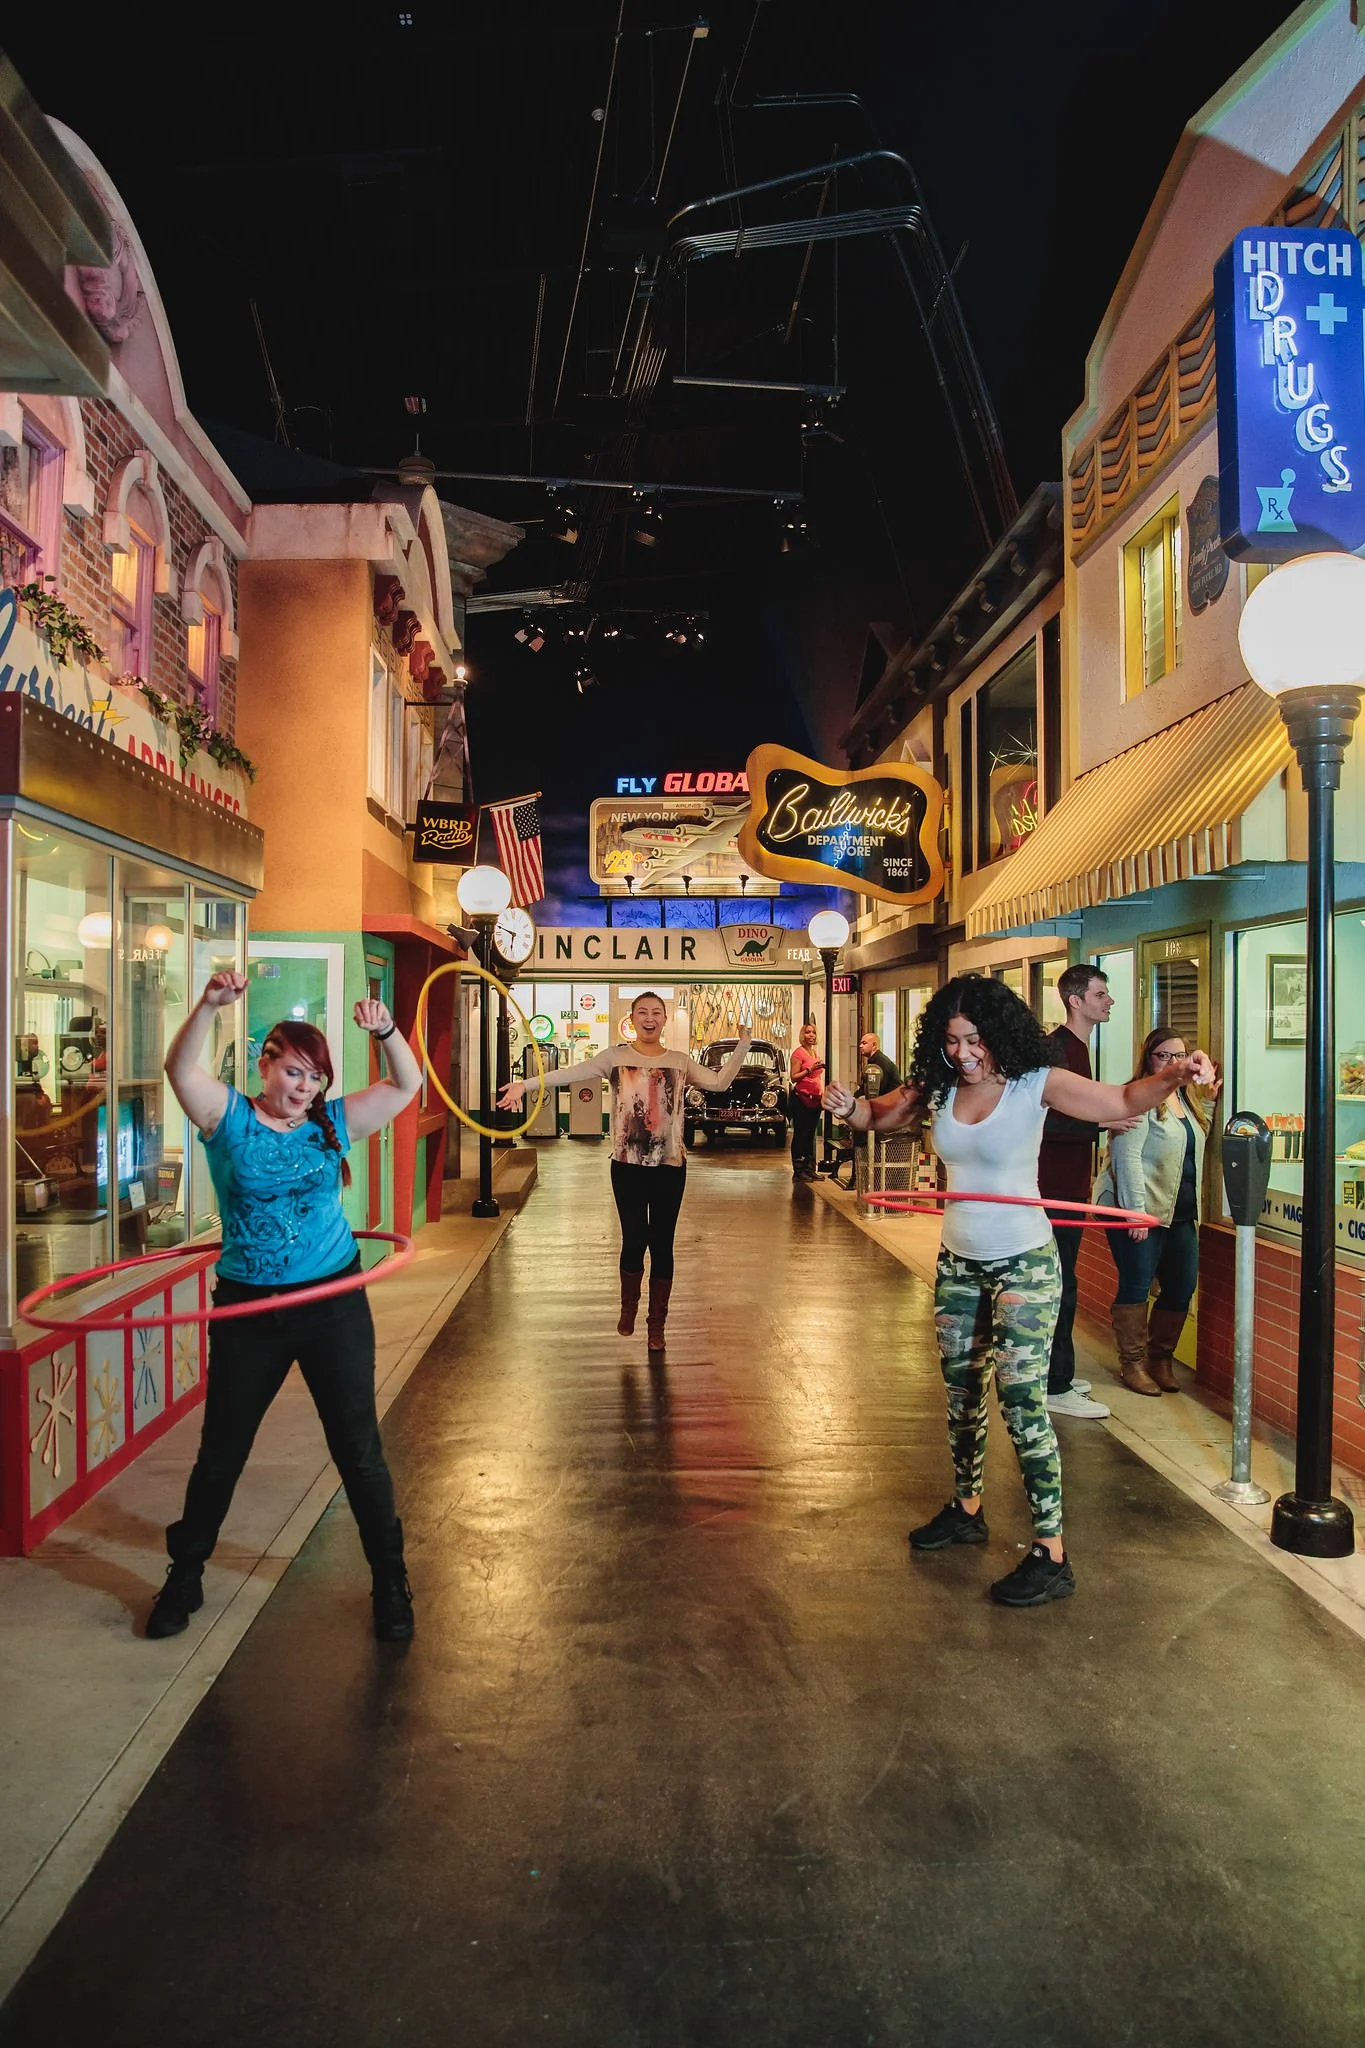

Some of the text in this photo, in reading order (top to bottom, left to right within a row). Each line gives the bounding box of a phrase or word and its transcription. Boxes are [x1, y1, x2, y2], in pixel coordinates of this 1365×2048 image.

[1243, 241, 1351, 276] HITCH
[1250, 270, 1352, 493] DRUGS
[617, 772, 750, 793] FLY GLOBA
[422, 816, 472, 830] WBRD
[611, 812, 679, 823] NEW YORK
[421, 830, 473, 849] Radio
[807, 835, 886, 847] DEPARTMENT
[833, 846, 871, 857] STORE
[883, 858, 913, 868] SINCE
[886, 868, 909, 877] 1866
[738, 928, 768, 939] DINO
[832, 978, 851, 992] EXIT
